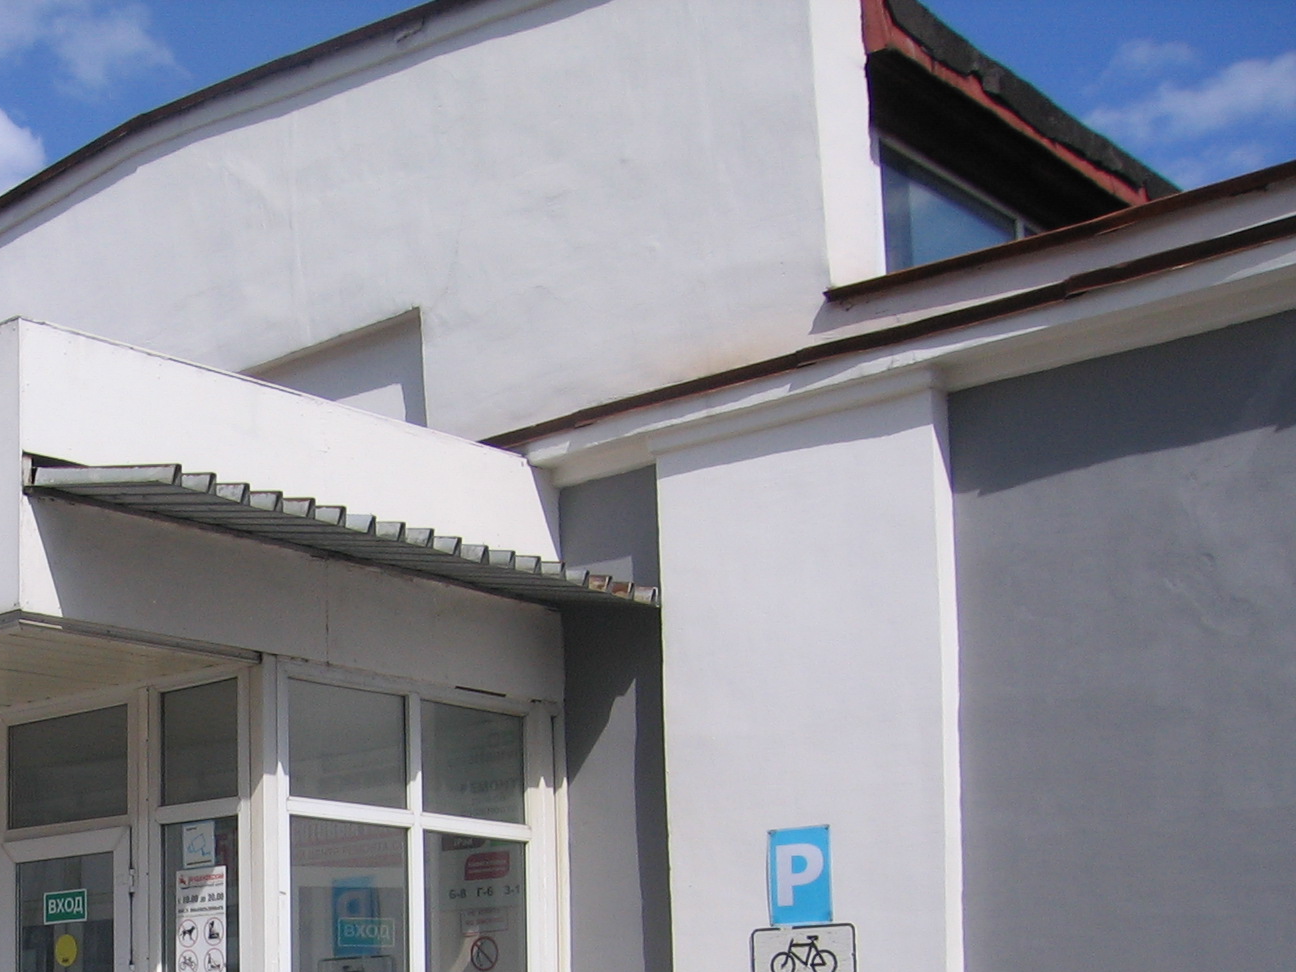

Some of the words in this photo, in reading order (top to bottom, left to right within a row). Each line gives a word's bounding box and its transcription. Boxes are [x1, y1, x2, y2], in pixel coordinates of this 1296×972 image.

[775, 843, 825, 907] P
[48, 896, 83, 914] ВХОД
[344, 924, 390, 940] ВХОД
